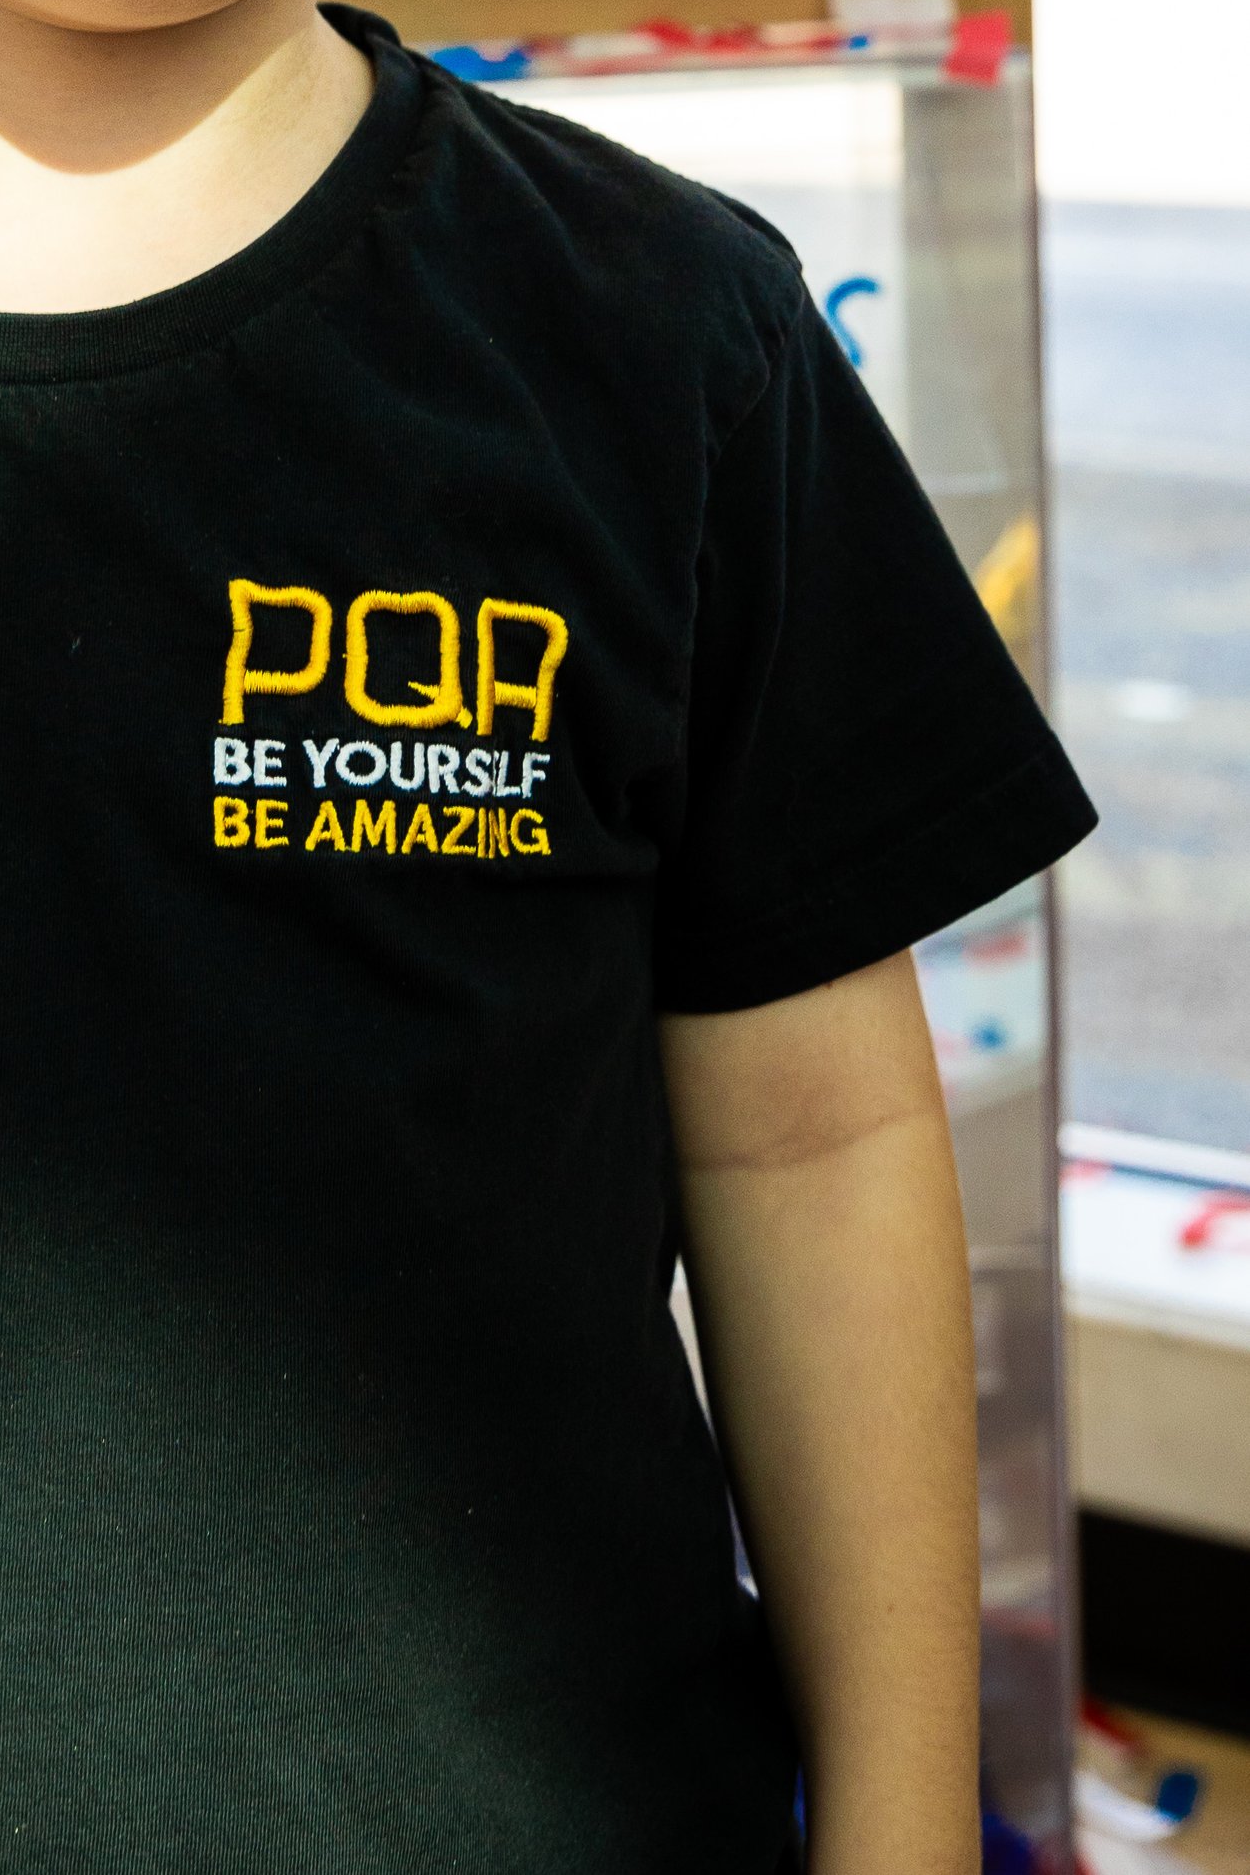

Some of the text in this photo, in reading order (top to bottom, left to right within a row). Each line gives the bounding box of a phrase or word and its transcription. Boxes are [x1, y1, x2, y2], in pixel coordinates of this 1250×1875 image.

[214, 737, 288, 787] BE
[213, 796, 551, 859] BE AMAZING
